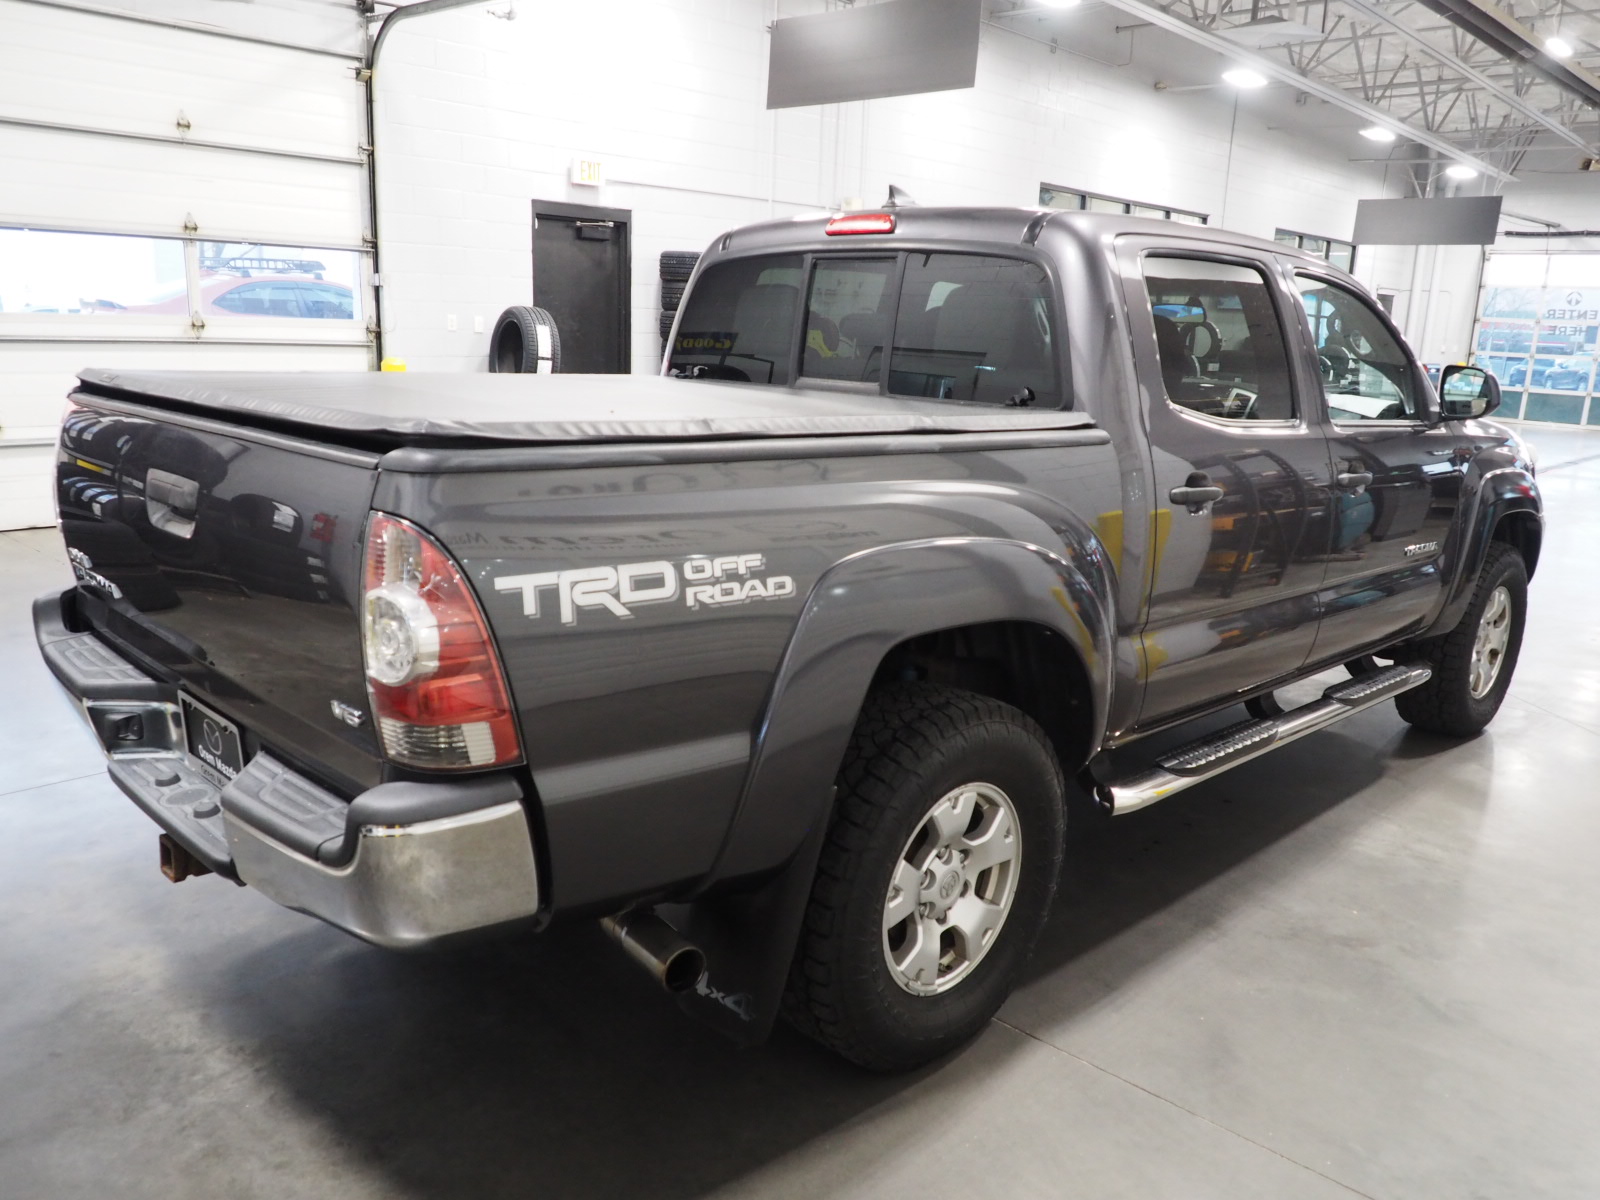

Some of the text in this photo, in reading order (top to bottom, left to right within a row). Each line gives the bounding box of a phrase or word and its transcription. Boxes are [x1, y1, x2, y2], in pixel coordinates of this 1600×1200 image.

[580, 160, 602, 182] EXIT
[494, 553, 766, 626] TRD OFF
[685, 575, 796, 610] ROAD
[198, 744, 237, 779] Orem Mazda
